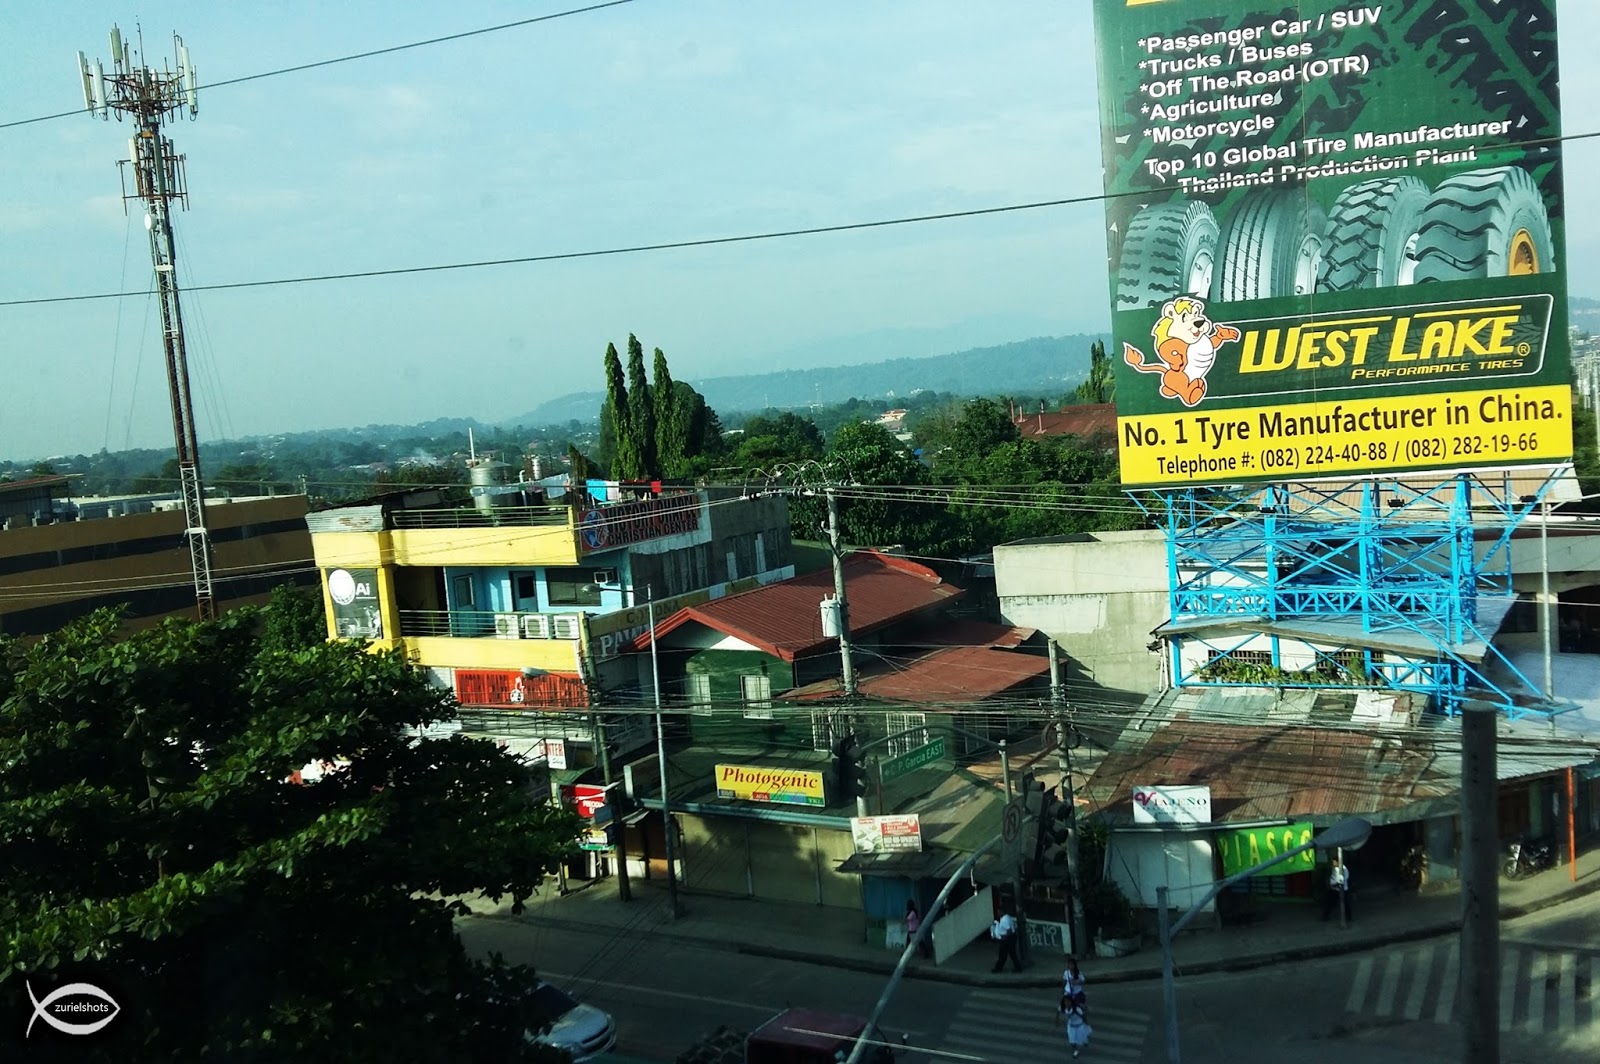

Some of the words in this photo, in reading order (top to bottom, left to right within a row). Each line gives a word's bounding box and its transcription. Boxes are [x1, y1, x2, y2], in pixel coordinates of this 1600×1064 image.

[1271, 17, 1312, 37] Car
[1316, 13, 1325, 31] /
[1331, 6, 1382, 29] SUV
[1228, 49, 1235, 65] /
[1242, 41, 1313, 64] Buses
[1188, 73, 1230, 93] The
[1236, 63, 1295, 88] Road
[1302, 54, 1369, 83] (OTR)
[1144, 157, 1185, 176] Top
[1192, 150, 1217, 170] 10
[1223, 140, 1297, 166] Global
[1303, 138, 1347, 156] Tire
[1354, 119, 1512, 150] Manufacturer
[1178, 167, 1274, 195] Thailand
[1281, 154, 1409, 183] Production
[1416, 145, 1477, 168] Plant
[1239, 326, 1379, 374] WEST
[1388, 315, 1519, 362] LAKE
[1351, 362, 1472, 380] PERFORMANCE
[1478, 358, 1524, 371] TIRES
[1125, 421, 1167, 447] No.
[1175, 418, 1188, 445] 1
[1196, 416, 1251, 450] Tyre
[1259, 404, 1437, 439] Manufacturer
[1446, 397, 1470, 426] in
[1479, 393, 1563, 424] China.
[1157, 453, 1237, 478] Telephone
[1241, 451, 1256, 469] #:
[1260, 446, 1301, 472] (082)
[1305, 441, 1388, 466] 224-40-88
[1392, 440, 1401, 463] /
[1405, 437, 1448, 463] (082)
[1452, 431, 1540, 456] 282-19-66
[608, 527, 662, 546] CHRISTIAN
[664, 519, 699, 536] CENTER
[905, 753, 925, 769] Garcia
[926, 742, 943, 760] EAST
[722, 766, 819, 790] Photogenic
